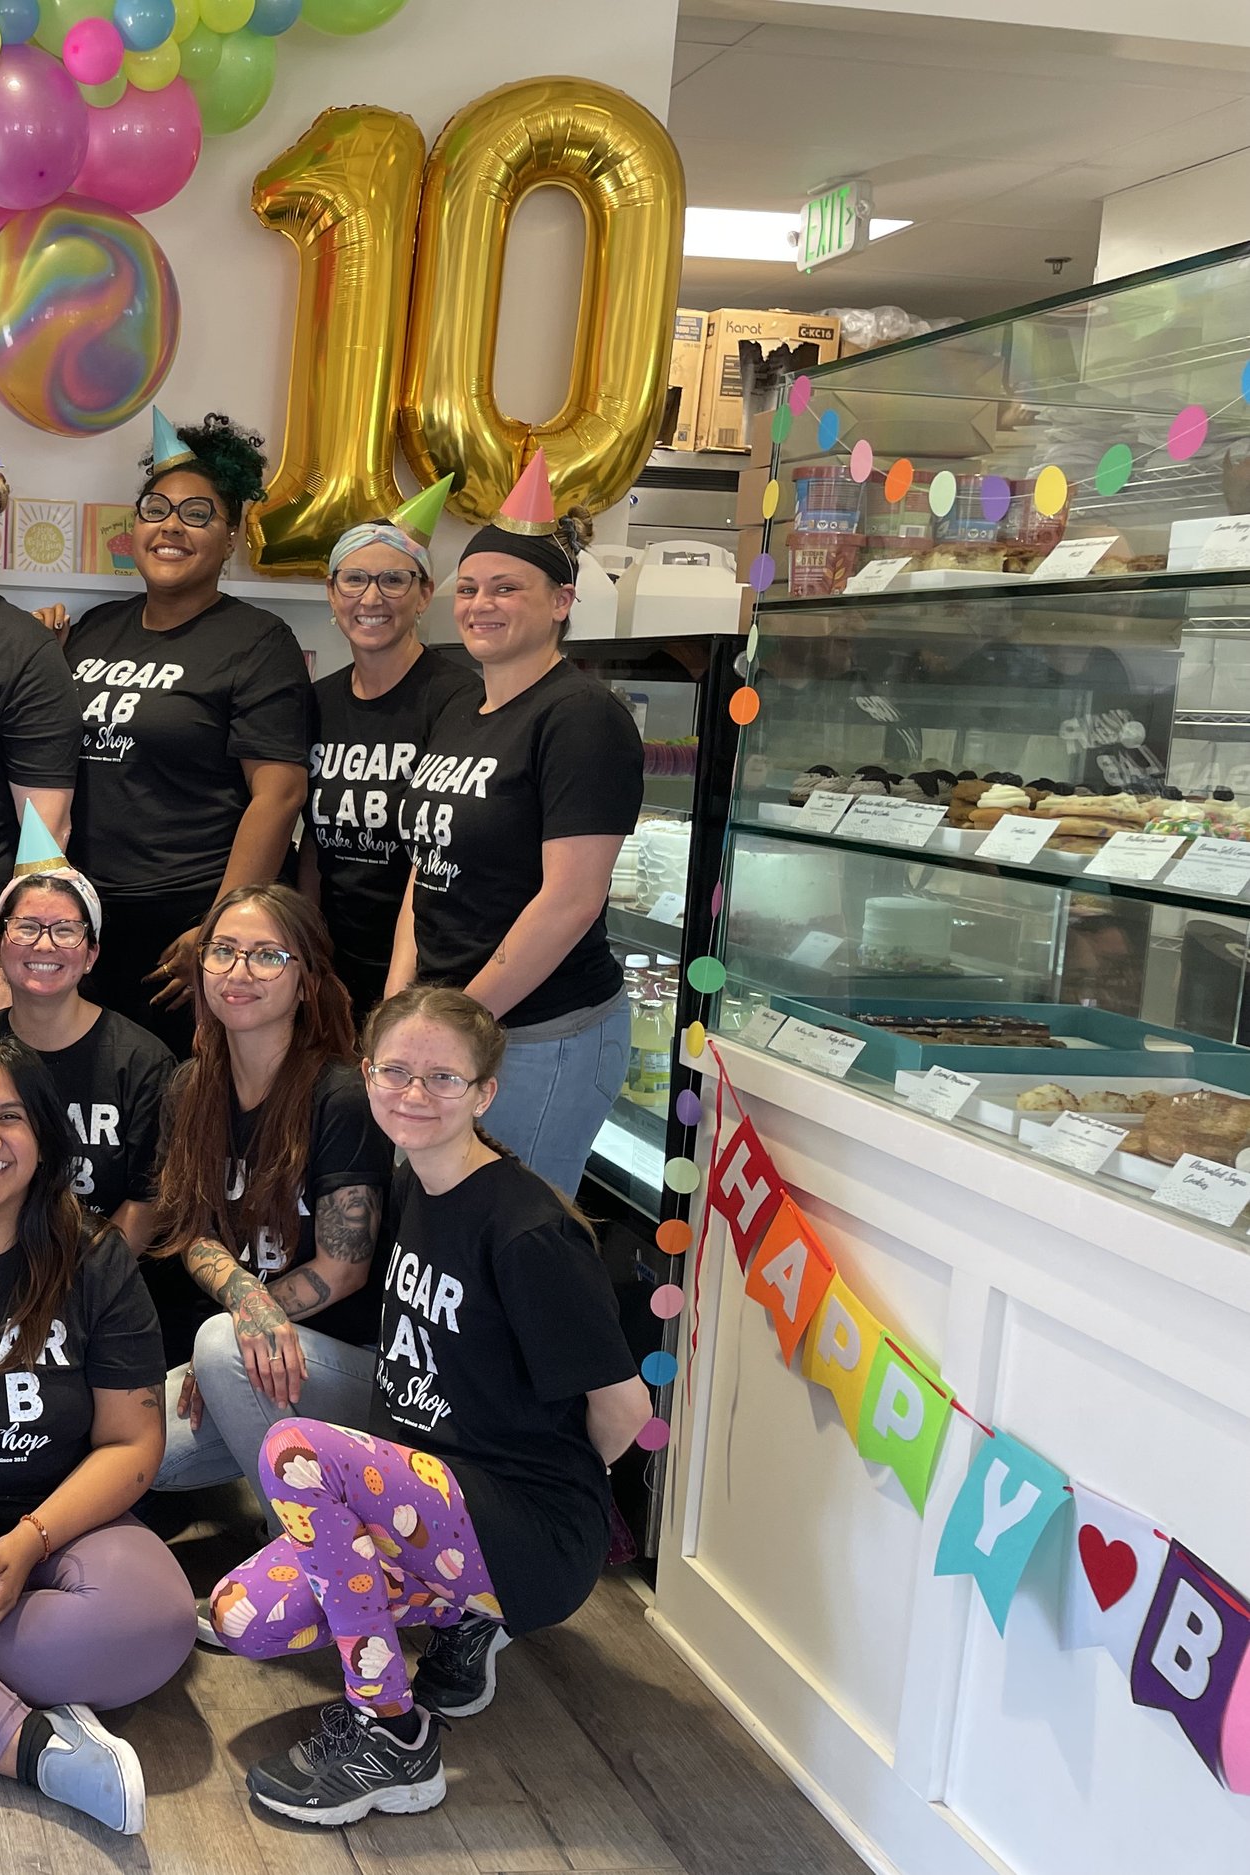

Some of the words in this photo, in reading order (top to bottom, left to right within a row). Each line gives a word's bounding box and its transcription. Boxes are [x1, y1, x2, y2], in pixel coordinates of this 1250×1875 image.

[805, 185, 851, 263] EXIT
[247, 75, 687, 578] 10
[726, 321, 762, 335] Karat
[800, 327, 832, 339] C-KC16
[801, 557, 824, 566] OATS
[72, 658, 184, 690] SUGAR
[82, 691, 141, 723] AB
[95, 722, 135, 758] Shop
[309, 743, 417, 781] SUGAR
[312, 788, 389, 828] LAB
[398, 799, 454, 847] LAB
[316, 827, 352, 849] Bake
[358, 828, 400, 861] Shop
[422, 845, 462, 888] Shop
[385, 1242, 464, 1334] UGAR
[719, 1140, 1042, 1557] HAPPY
[397, 1373, 453, 1428] Shop
[305, 1797, 320, 1806] AT
